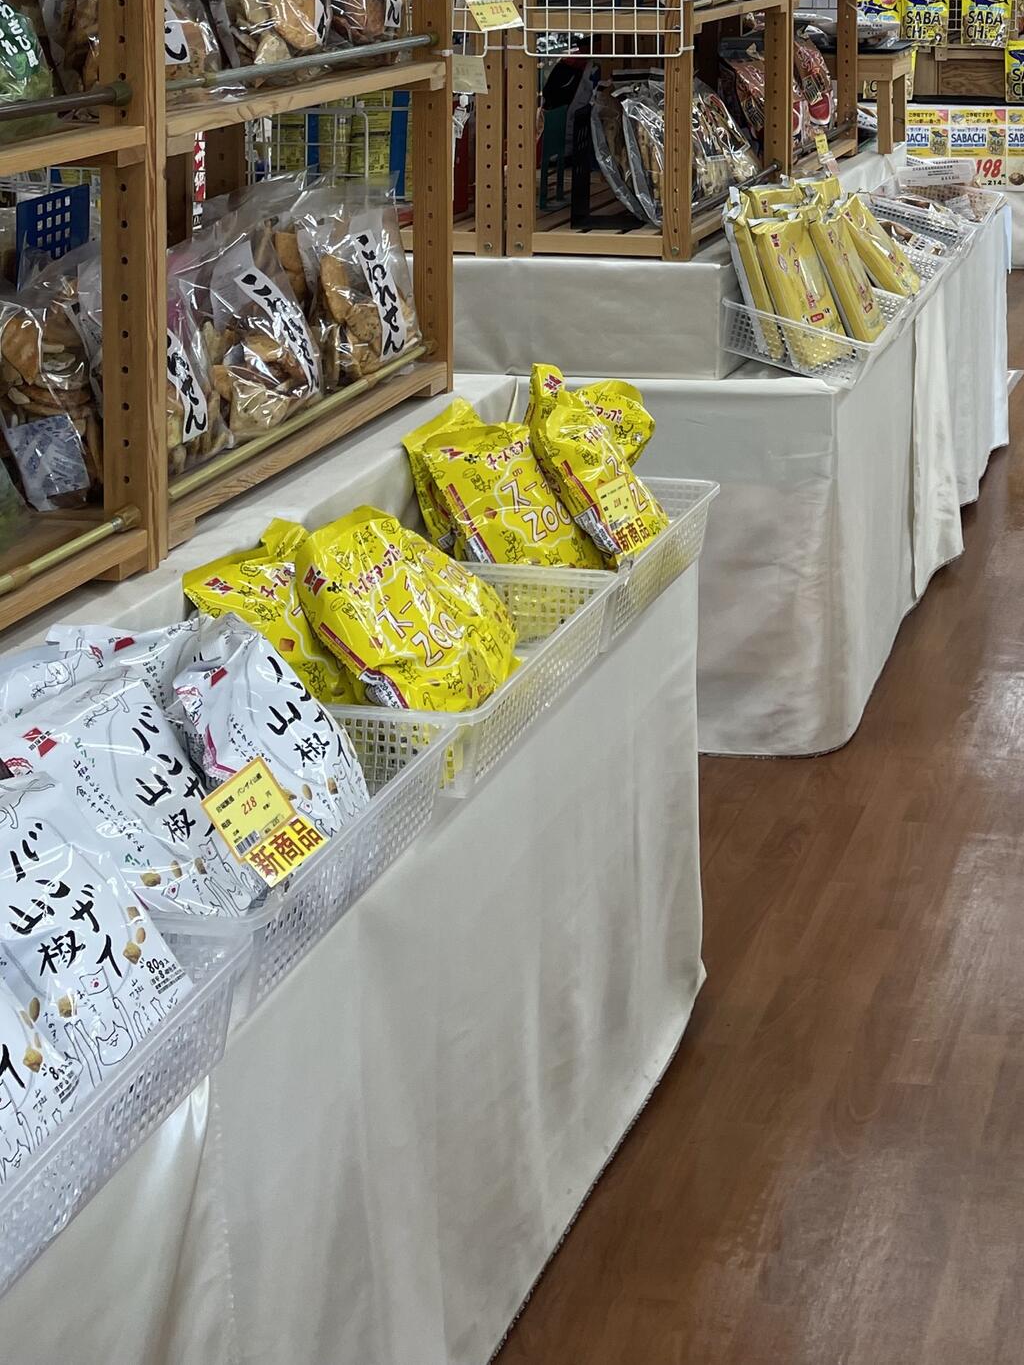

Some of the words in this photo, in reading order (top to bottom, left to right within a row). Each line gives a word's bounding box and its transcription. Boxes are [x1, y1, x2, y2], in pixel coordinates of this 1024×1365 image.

[906, 11, 942, 25] SABA
[906, 25, 928, 39] CHi
[966, 25, 988, 39] CHi
[968, 10, 1003, 25] SABA
[950, 134, 987, 144] SABACHi
[976, 159, 1003, 179] 198
[357, 234, 405, 355] こわれせん
[615, 516, 651, 553] 新商品
[411, 611, 466, 668] ZOO
[266, 699, 331, 769] 山椒
[134, 773, 197, 844] 山椒
[240, 795, 258, 816] 218
[249, 817, 324, 879] 新商品
[8, 822, 123, 978] バンザイ
[8, 897, 87, 977] 山椒
